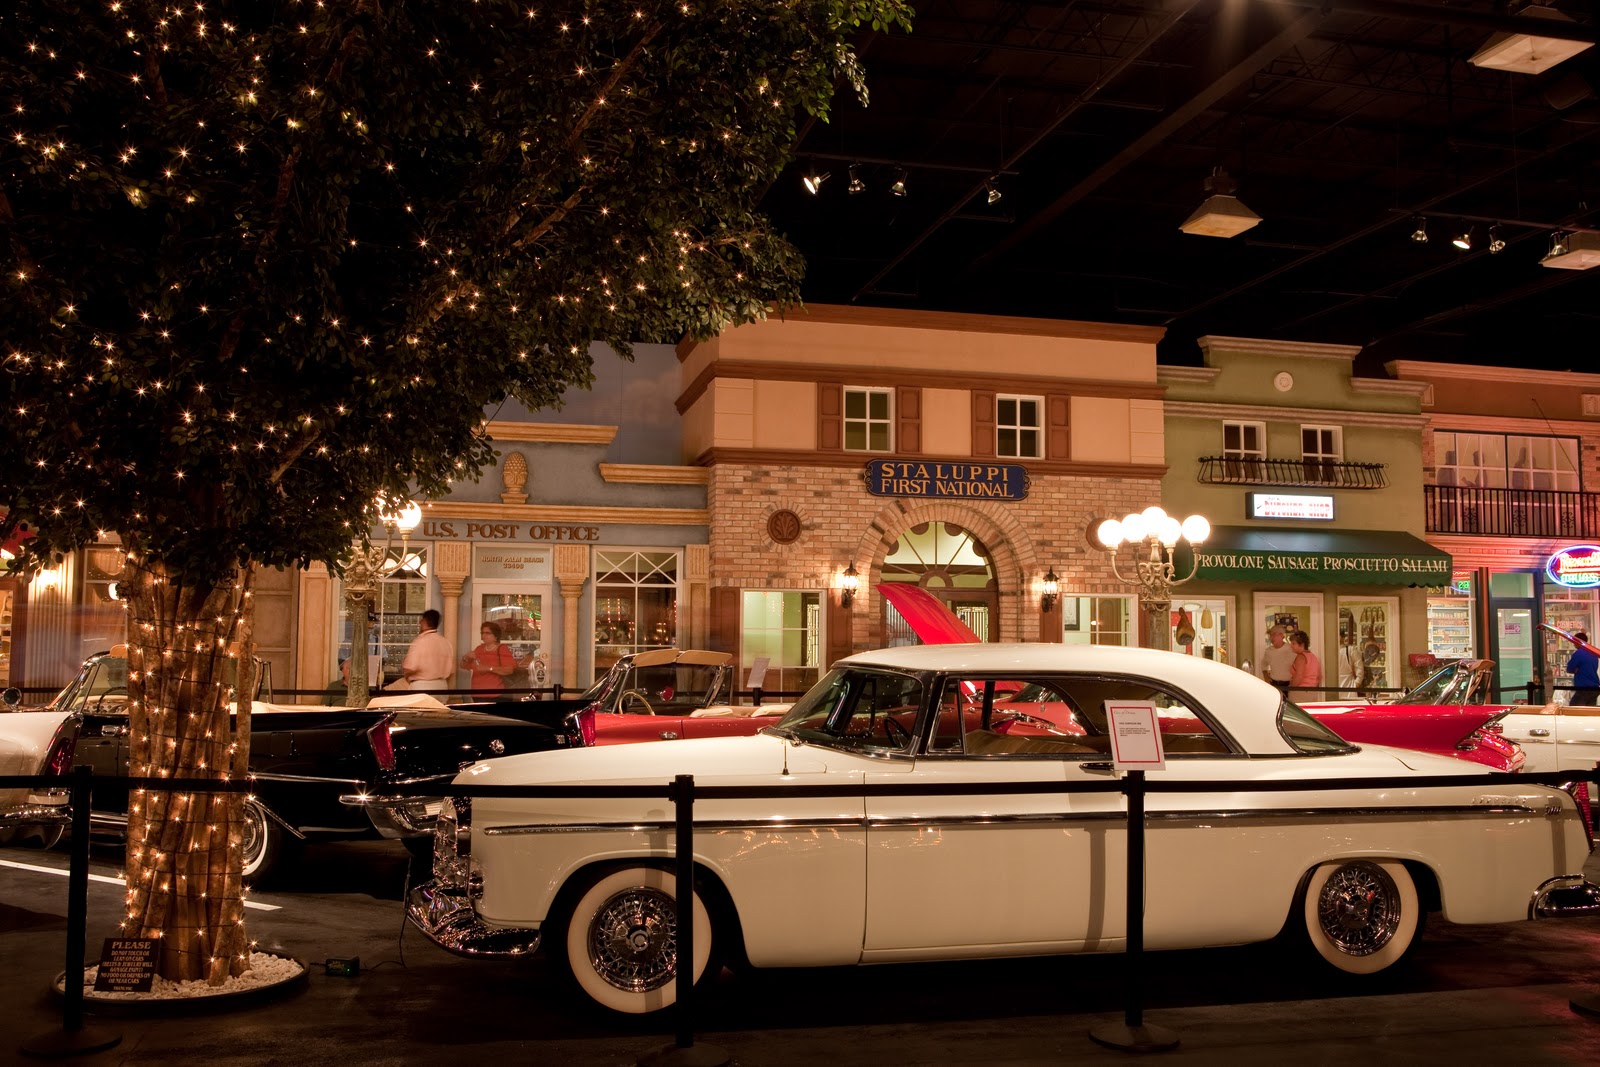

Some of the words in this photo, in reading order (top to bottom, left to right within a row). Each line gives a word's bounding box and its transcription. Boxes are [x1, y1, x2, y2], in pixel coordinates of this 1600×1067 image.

[881, 479, 930, 494] FIRST
[936, 480, 1014, 498] NATIONAL
[423, 521, 458, 538] U.S.
[466, 523, 520, 539] POST
[529, 525, 600, 541] OFFICE
[1194, 553, 1264, 569] PROVOLONE
[1268, 555, 1319, 570] SAUSAGE
[1323, 557, 1399, 572] PROSCIUTTO
[1401, 558, 1448, 573] SALAMI
[111, 941, 152, 949] PLEASE
